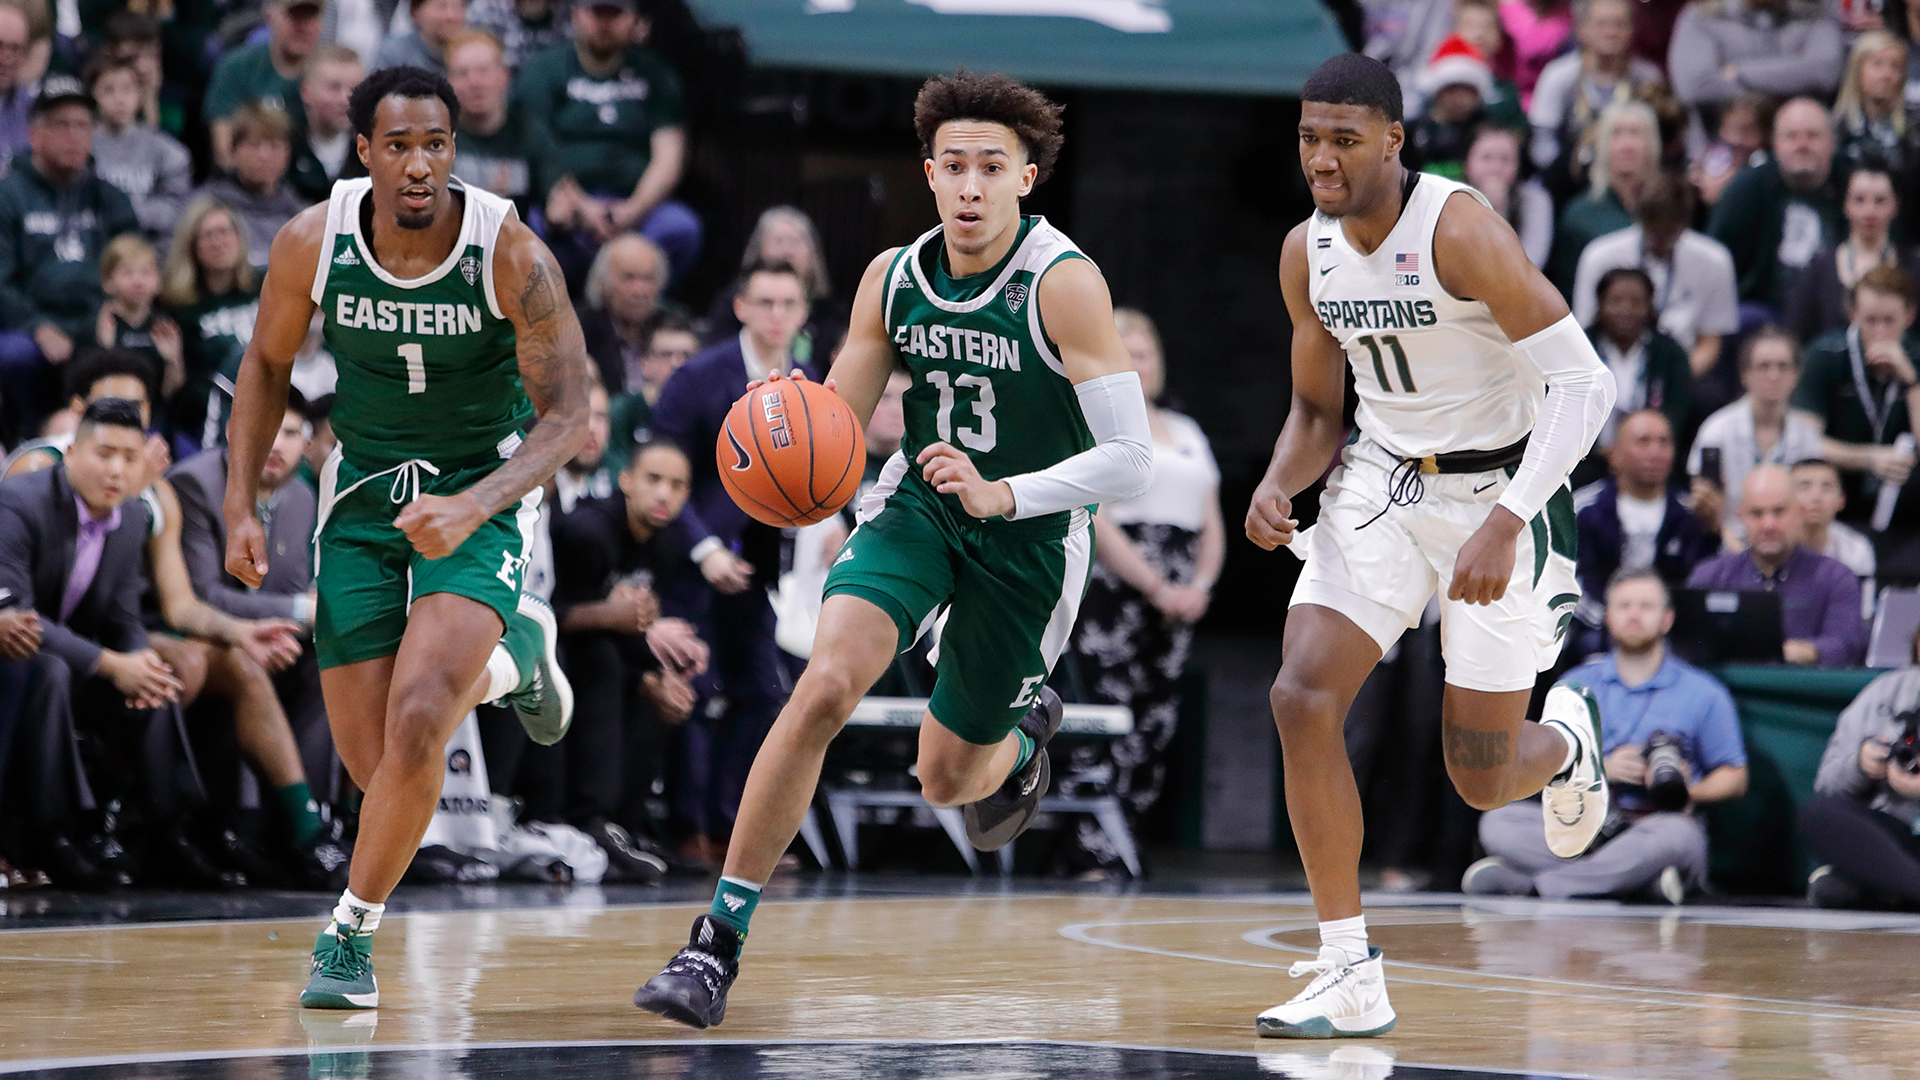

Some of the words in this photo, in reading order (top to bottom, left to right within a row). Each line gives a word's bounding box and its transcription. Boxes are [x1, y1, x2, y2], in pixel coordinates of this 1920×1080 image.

[336, 294, 482, 336] EASTERN
[1317, 300, 1437, 329] SPARTANS
[397, 342, 427, 395] 1
[894, 323, 1022, 372] EASTERN
[1357, 333, 1418, 394] 11
[761, 391, 791, 451] ELITE
[926, 369, 997, 454] 13
[495, 549, 524, 592] E
[1008, 674, 1045, 709] E
